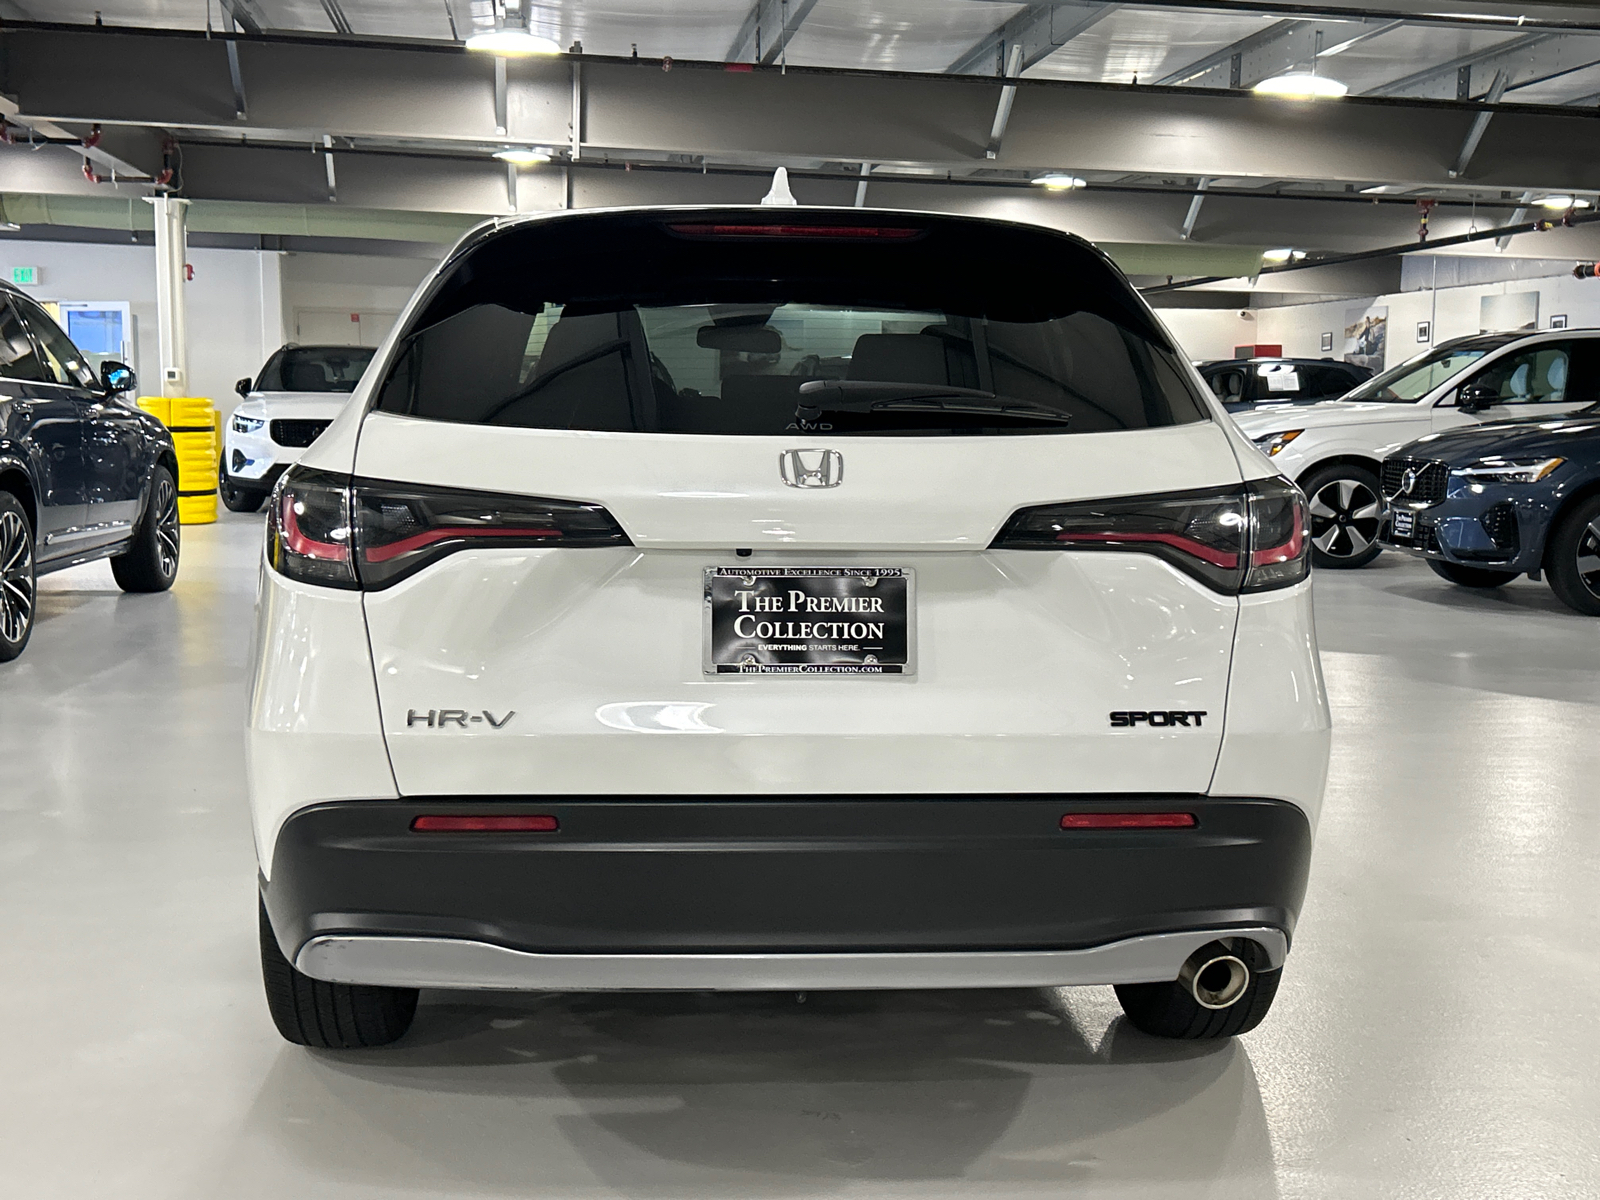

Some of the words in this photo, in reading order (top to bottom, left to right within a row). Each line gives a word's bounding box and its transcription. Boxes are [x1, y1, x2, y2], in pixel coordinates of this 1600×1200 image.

[13, 268, 33, 283] EXIT
[720, 568, 782, 576] AUTOMOTIVE
[784, 568, 842, 576] EXCELLENCE
[844, 568, 872, 576] SINCE
[875, 568, 901, 576] 1995
[734, 590, 783, 613] THE
[788, 590, 884, 613] PREMIER
[733, 614, 884, 639] COLLECTION
[407, 708, 516, 729] HR-V
[1109, 710, 1208, 727] SPORT
